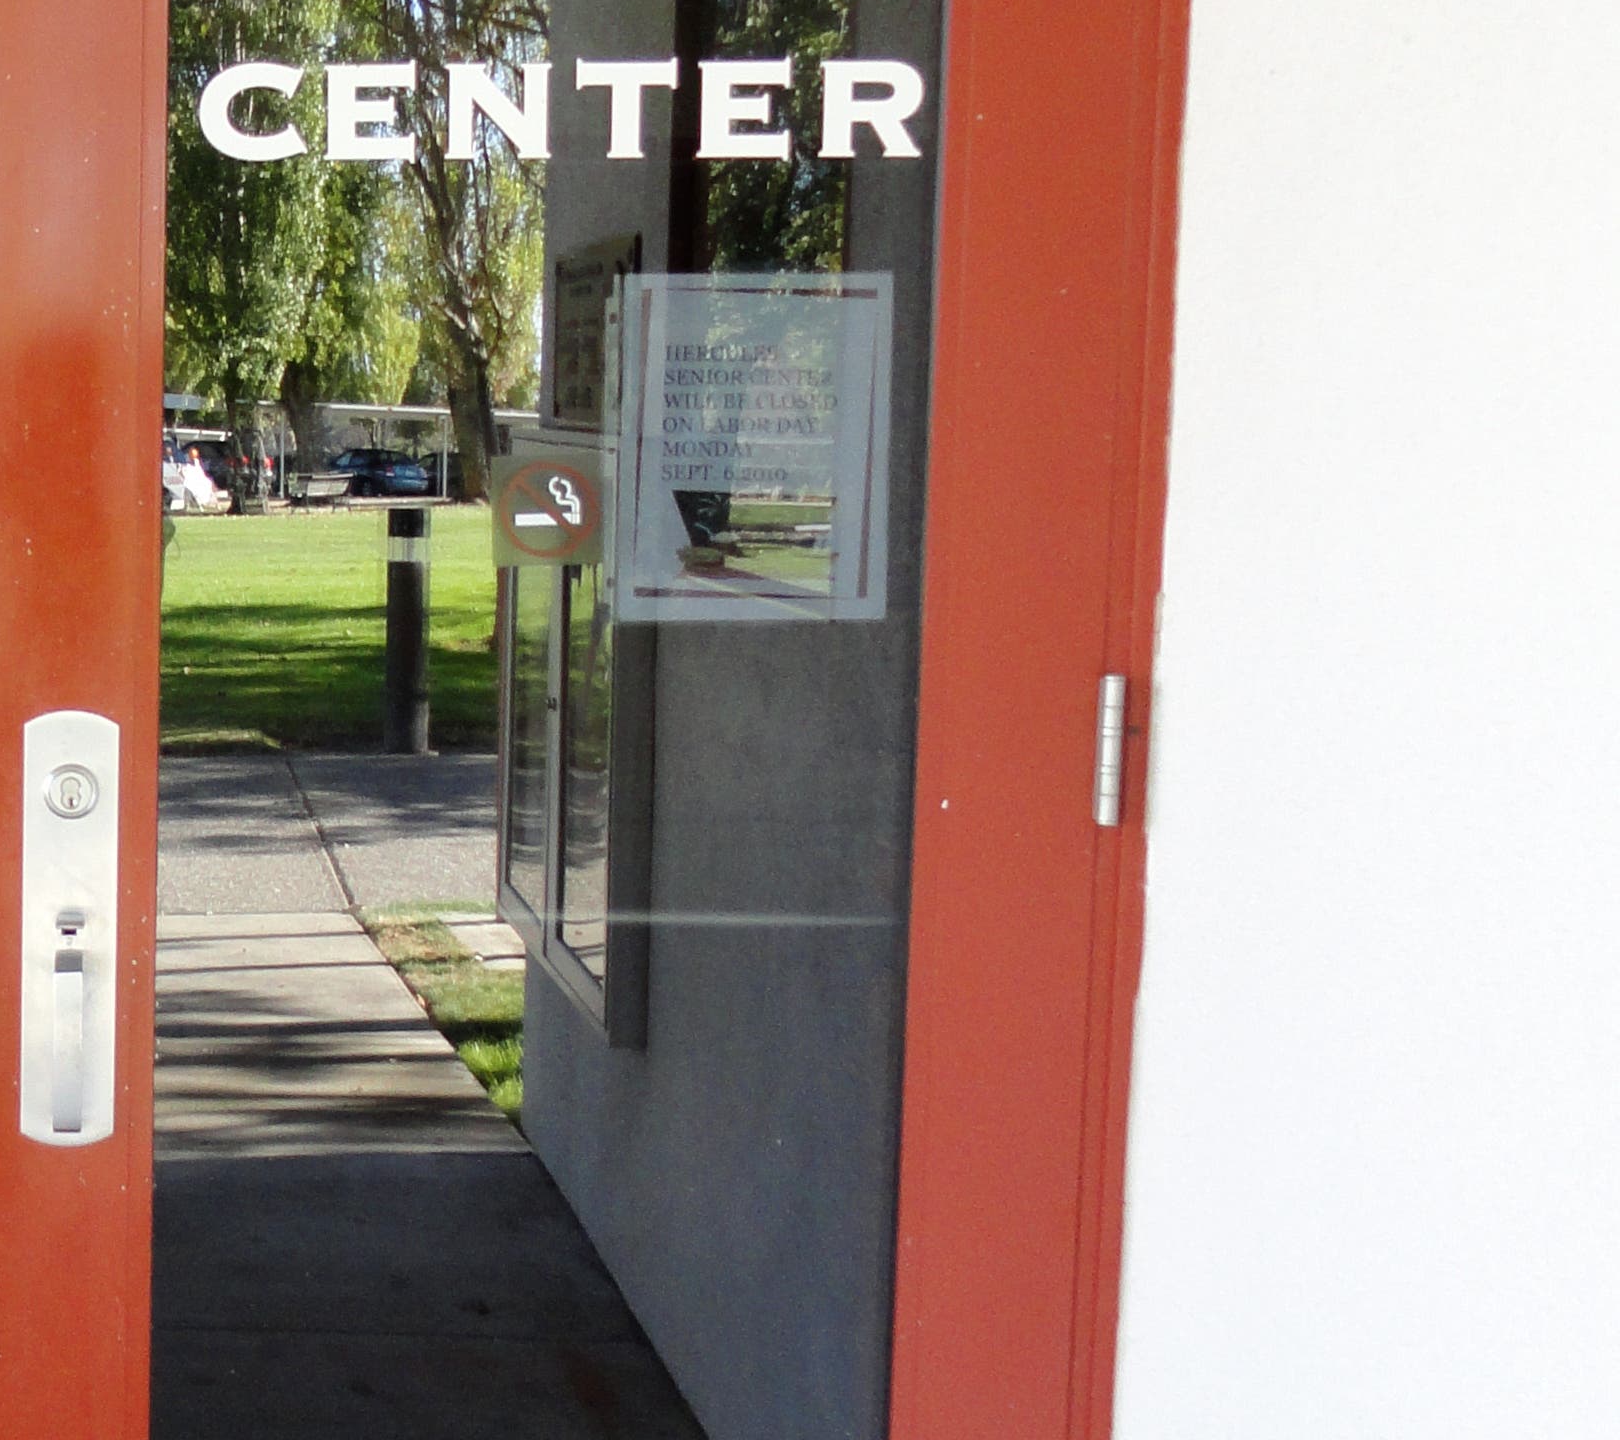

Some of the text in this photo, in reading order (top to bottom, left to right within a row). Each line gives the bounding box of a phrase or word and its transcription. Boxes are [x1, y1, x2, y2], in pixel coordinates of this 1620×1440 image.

[198, 57, 926, 162] CENTER
[664, 368, 832, 386] SENIOR CENTER
[664, 392, 716, 410] WILL
[662, 416, 693, 433] ON
[777, 416, 819, 434] DAY
[662, 440, 754, 457] MONDAY
